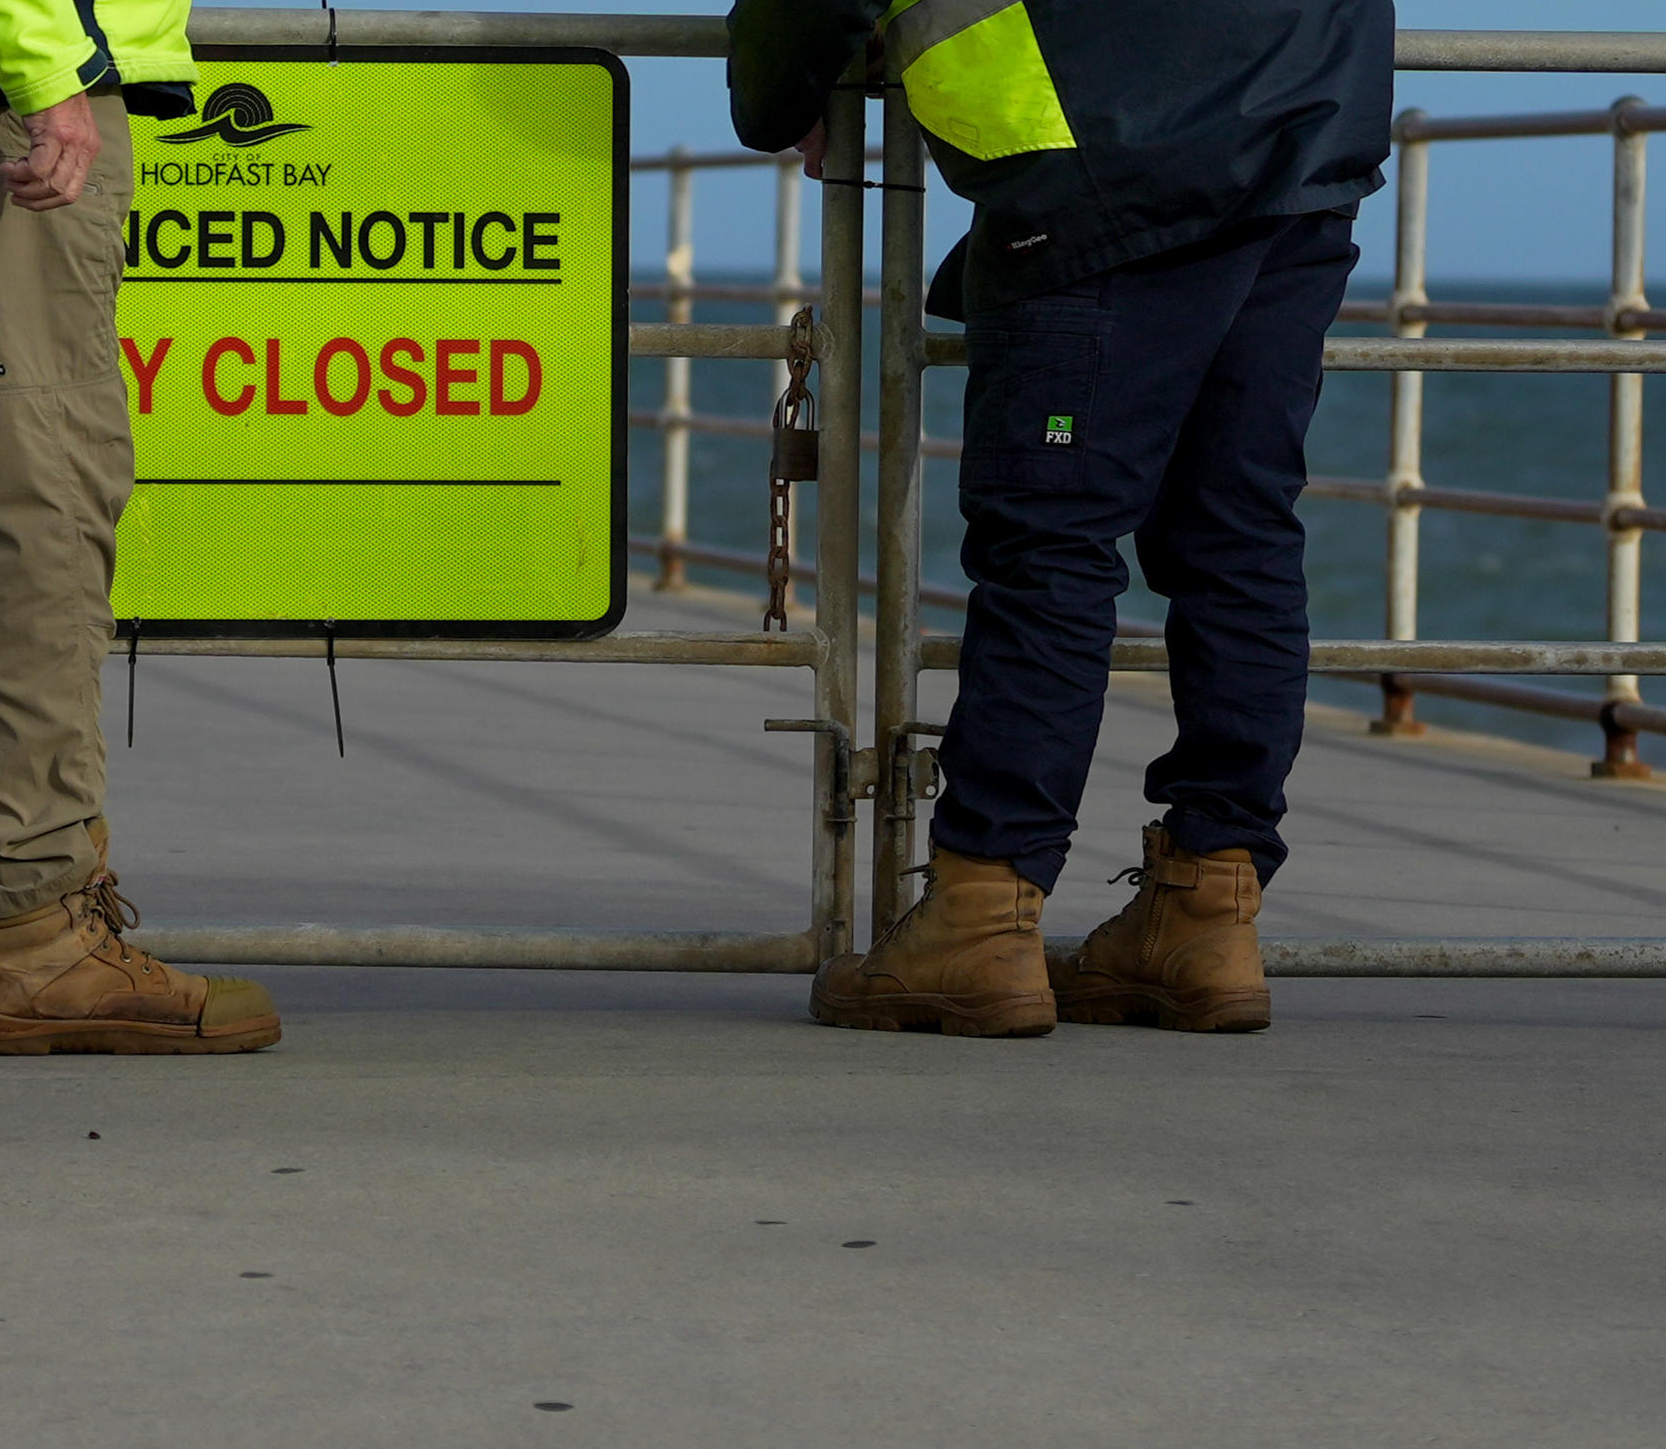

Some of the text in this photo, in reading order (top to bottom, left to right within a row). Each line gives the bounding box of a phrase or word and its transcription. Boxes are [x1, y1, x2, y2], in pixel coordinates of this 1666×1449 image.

[212, 153, 238, 161] CITY
[141, 162, 332, 187] HOLDFAST BAY
[310, 210, 562, 271] NOTICE
[201, 336, 543, 417] CLOSED
[1045, 431, 1072, 444] FXD
